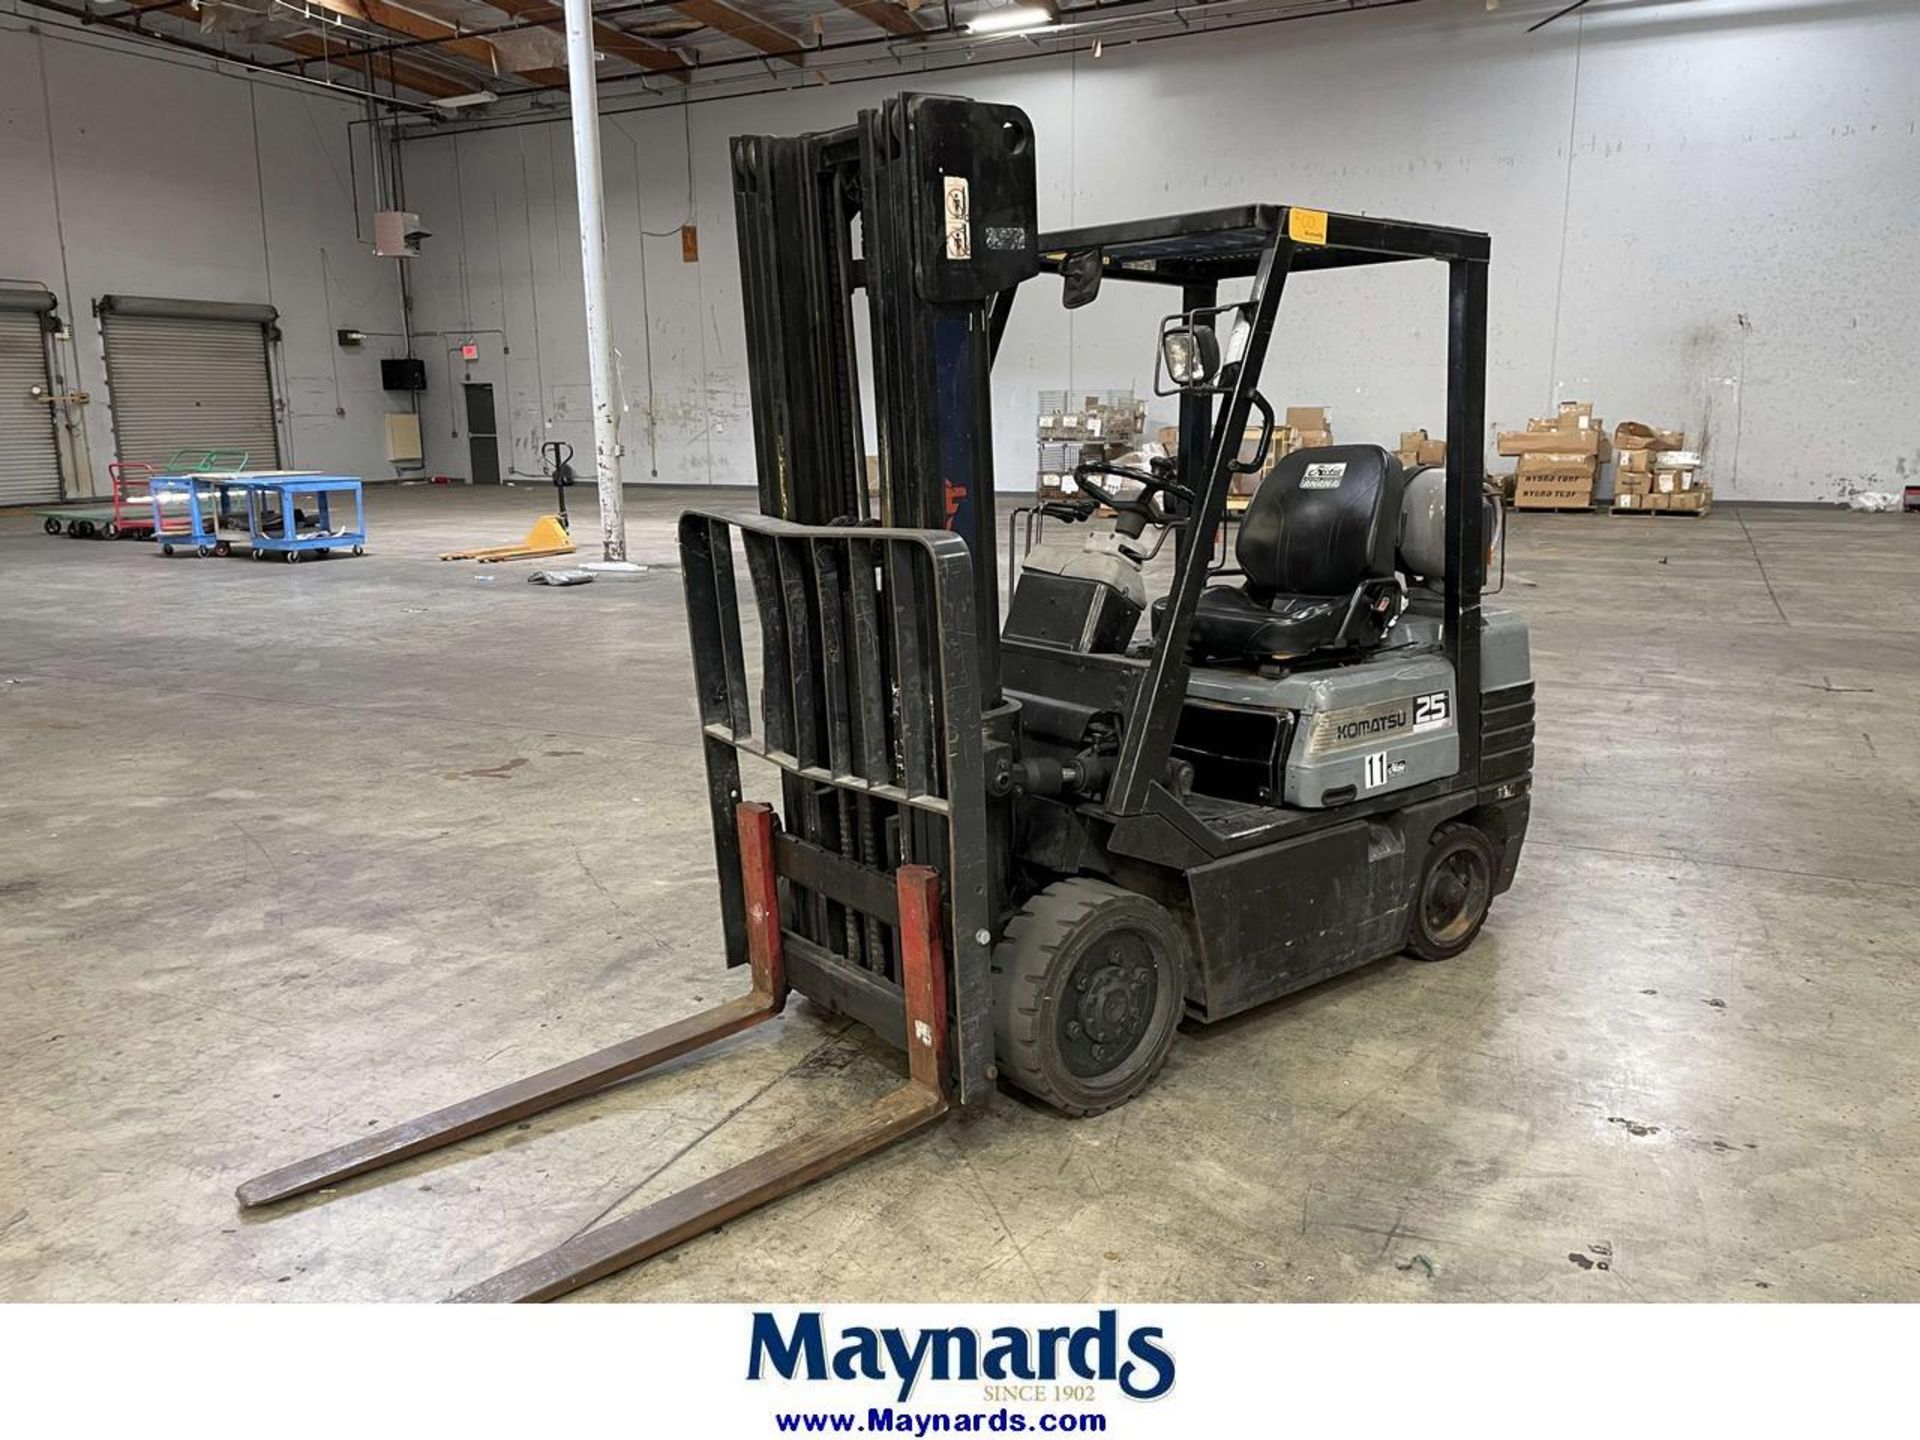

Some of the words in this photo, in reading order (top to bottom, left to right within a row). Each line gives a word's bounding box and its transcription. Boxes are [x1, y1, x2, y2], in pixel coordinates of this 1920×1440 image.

[1337, 711, 1406, 739] KOMATSU
[1415, 692, 1447, 723] 25
[1368, 753, 1384, 786] 11
